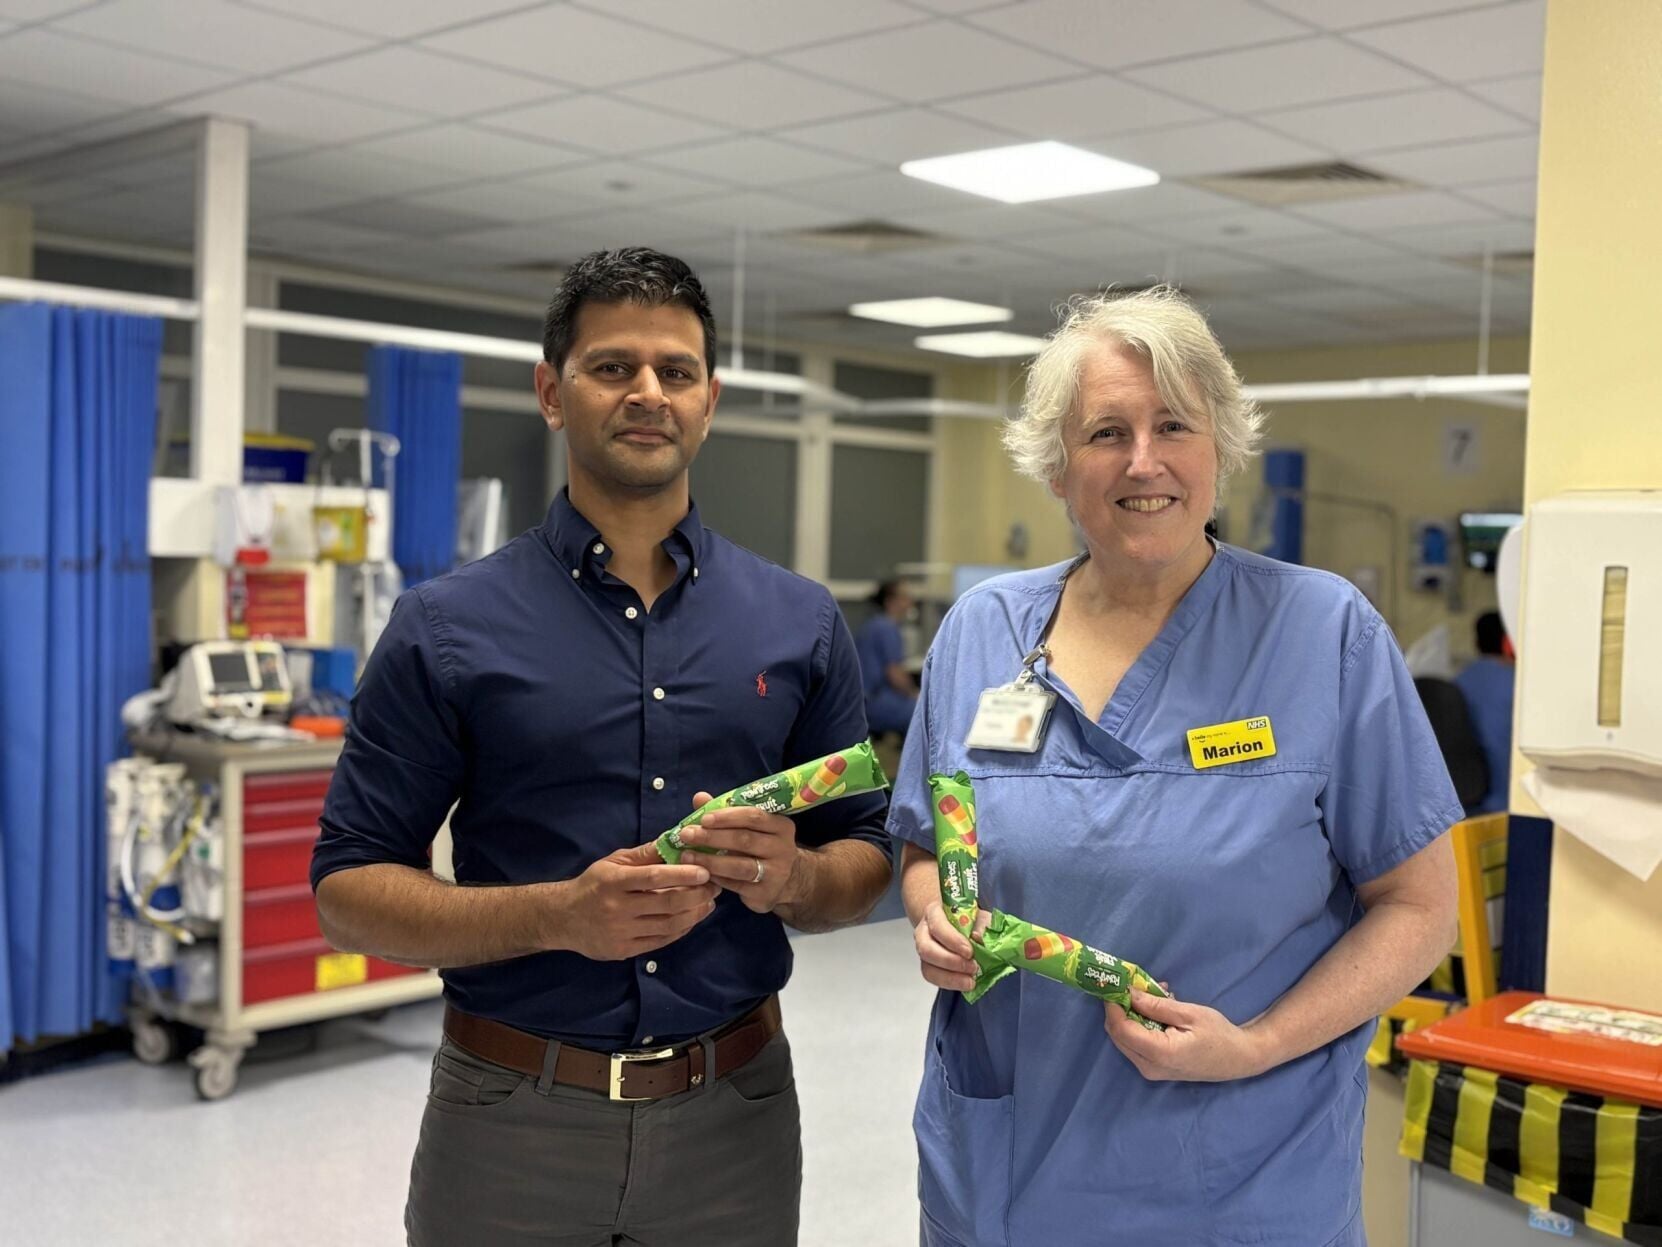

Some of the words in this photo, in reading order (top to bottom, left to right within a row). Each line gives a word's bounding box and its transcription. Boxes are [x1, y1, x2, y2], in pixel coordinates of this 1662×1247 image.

[1450, 428, 1473, 464] 7
[1247, 720, 1266, 730] NHS
[1202, 741, 1263, 760] Marion
